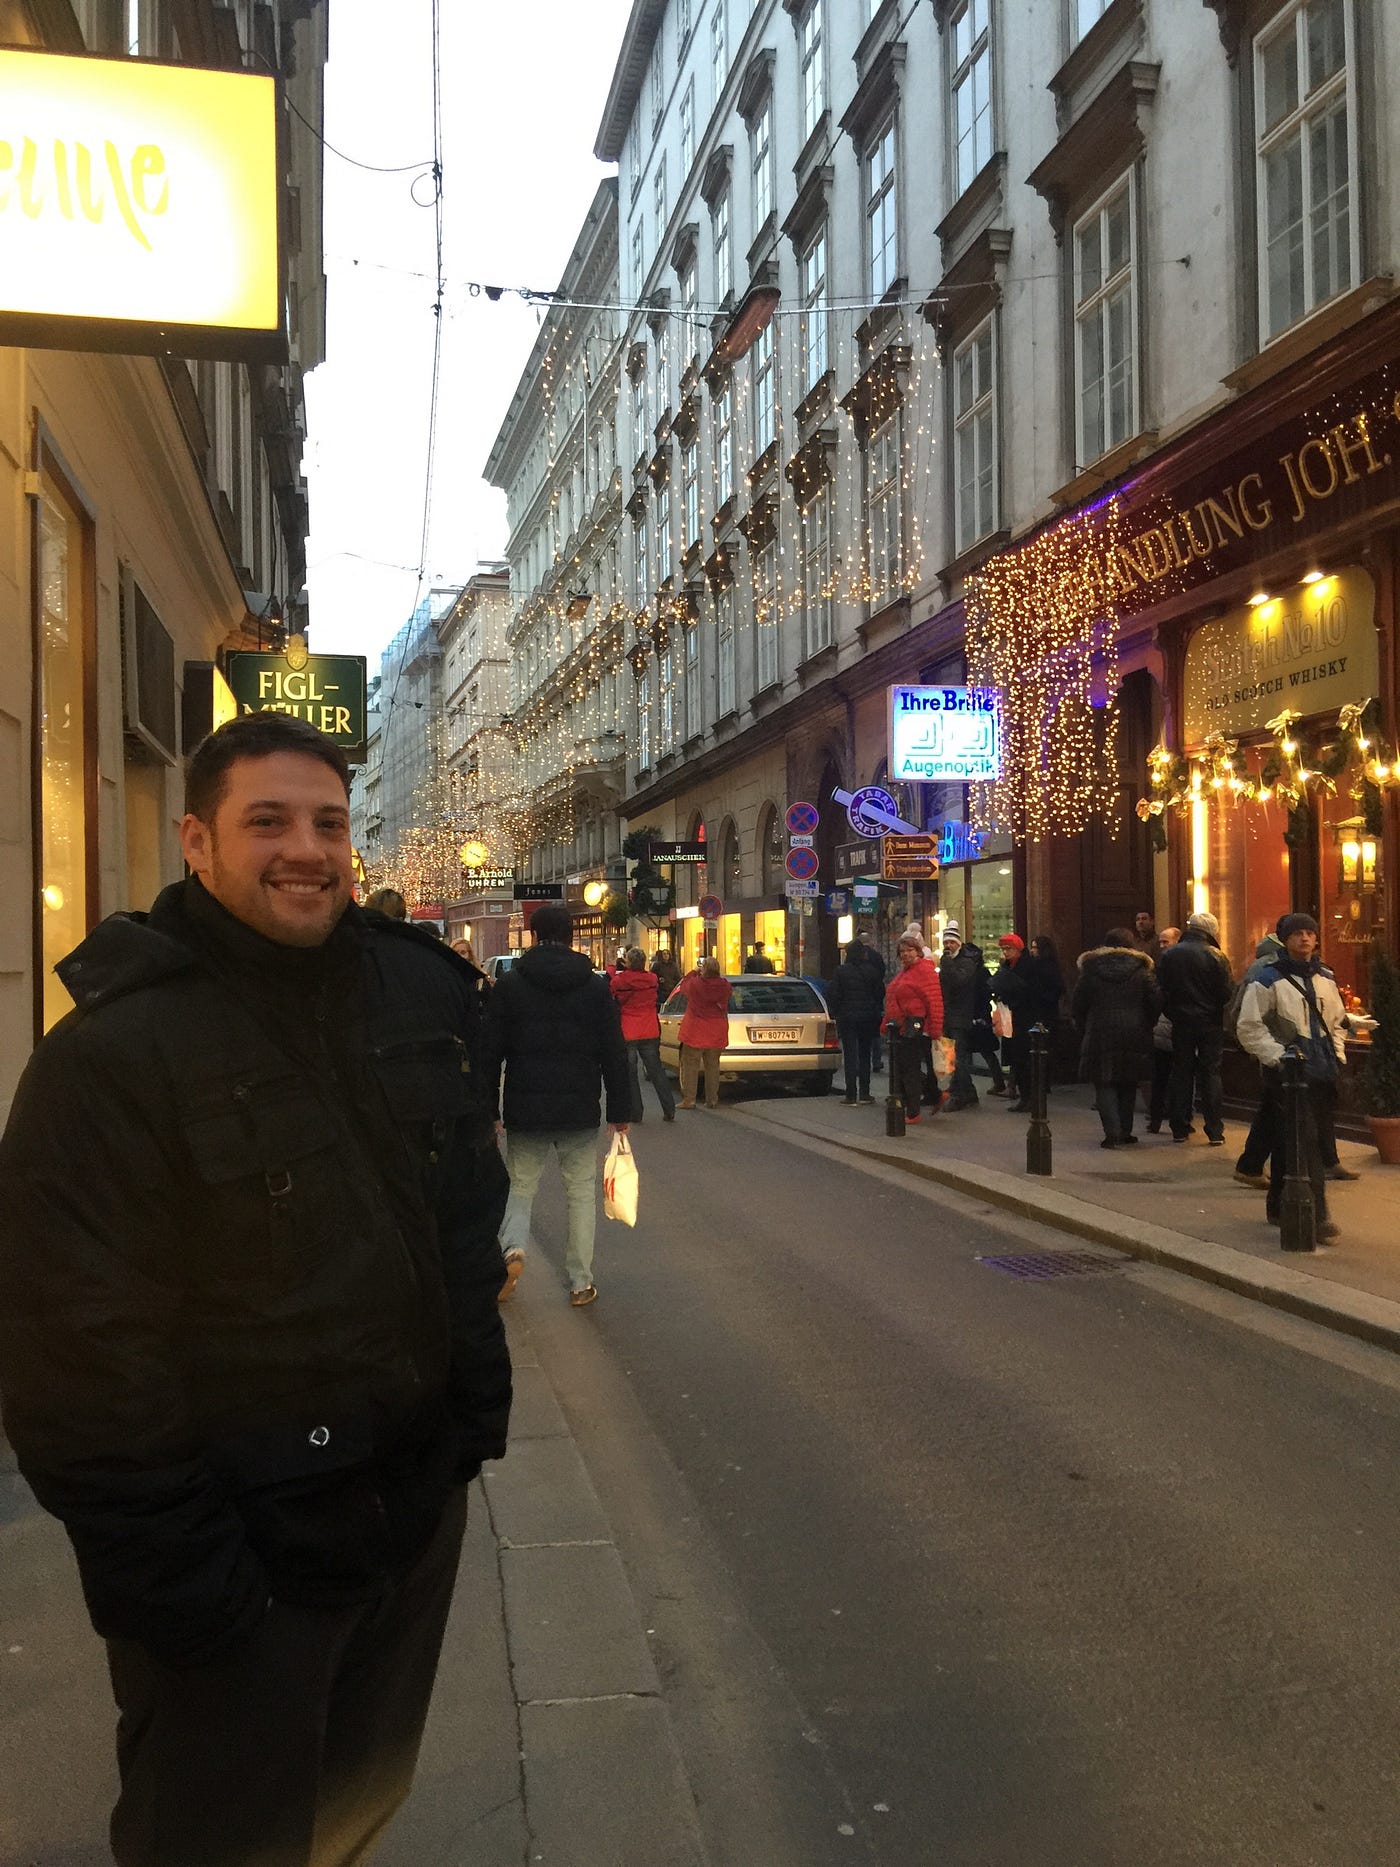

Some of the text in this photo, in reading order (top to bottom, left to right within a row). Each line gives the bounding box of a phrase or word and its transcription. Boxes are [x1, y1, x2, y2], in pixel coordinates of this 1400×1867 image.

[1278, 412, 1393, 523] JOH.
[258, 671, 340, 701] FIGL-
[1233, 677, 1285, 704] SCOTCH
[1288, 656, 1349, 688] WHISKY
[901, 692, 941, 711] Ihre
[859, 787, 894, 811] TABAK
[851, 807, 885, 836] TRAFIK
[652, 854, 706, 862] JANAUSCHEK
[468, 879, 505, 888] UHREN
[480, 869, 513, 878] Arnold
